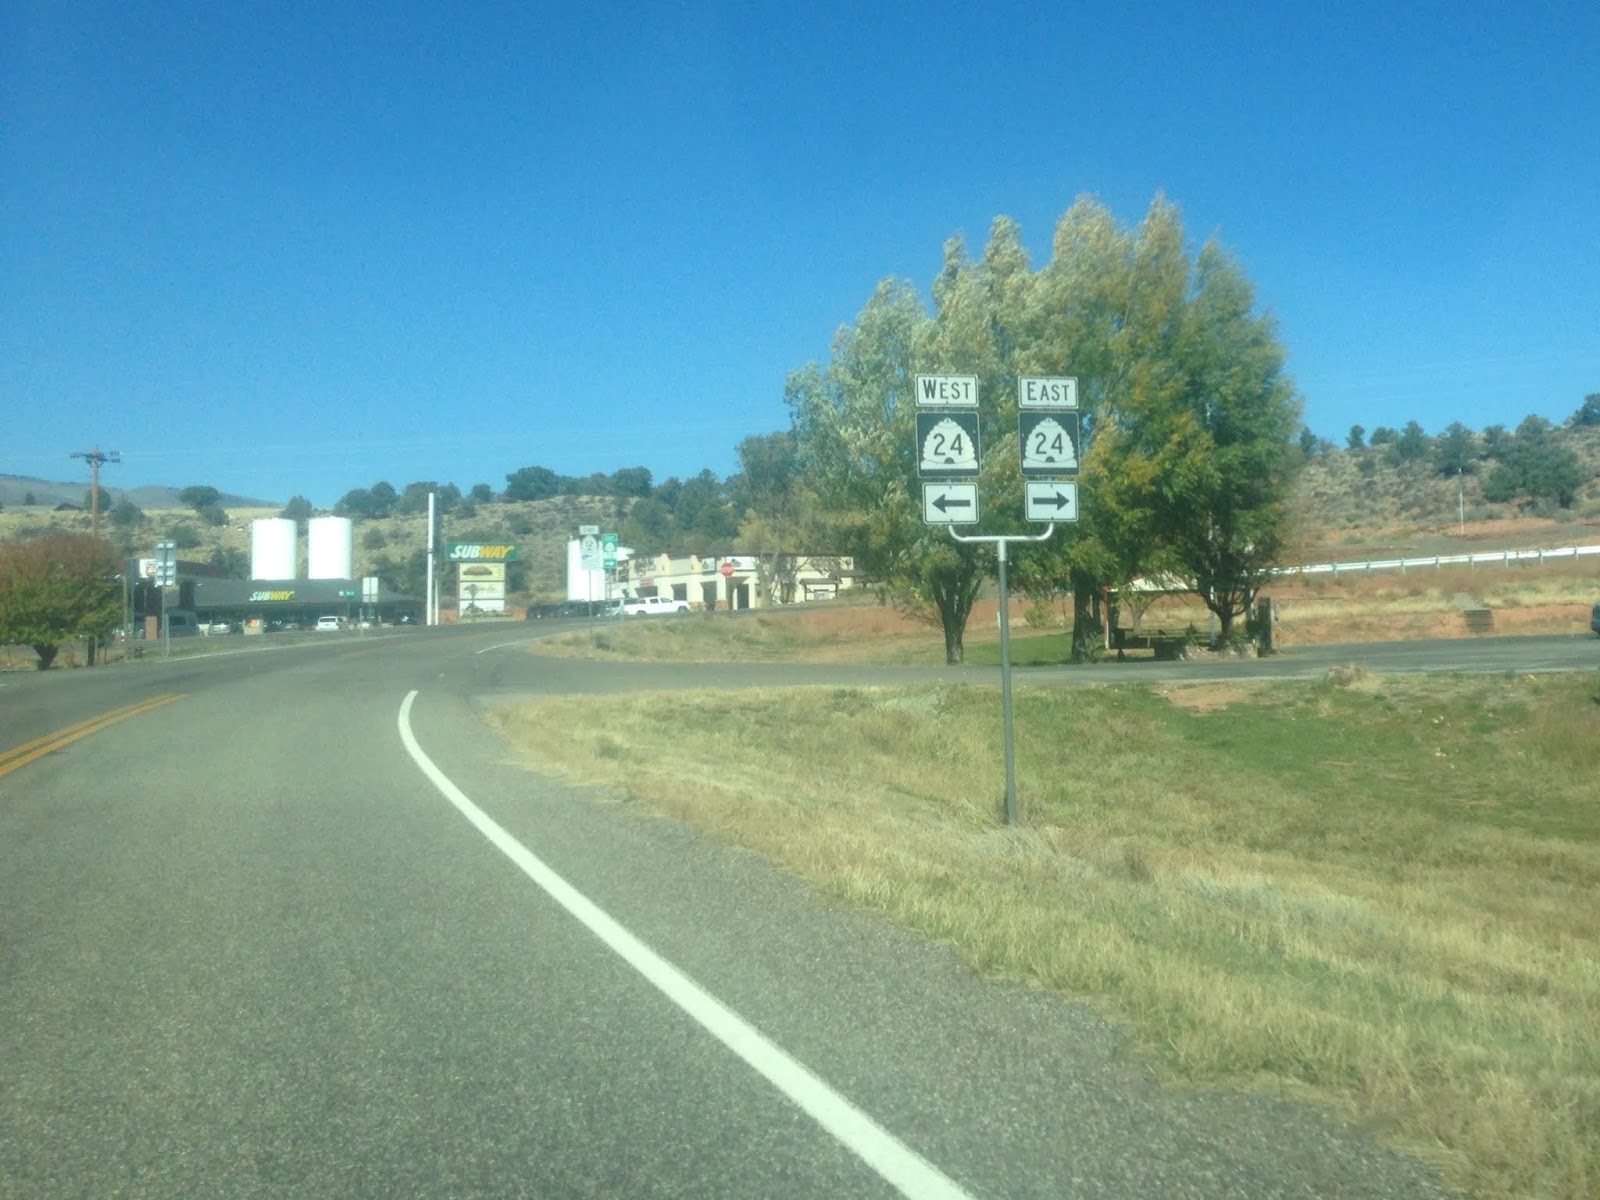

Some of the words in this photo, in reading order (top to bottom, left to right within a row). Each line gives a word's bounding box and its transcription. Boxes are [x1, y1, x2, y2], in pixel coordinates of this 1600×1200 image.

[922, 379, 971, 400] WEST
[1027, 381, 1070, 402] EAST
[933, 433, 963, 456] 24
[1035, 432, 1063, 455] 24
[449, 544, 515, 559] SUBWAY
[248, 591, 295, 602] SUBWAY
